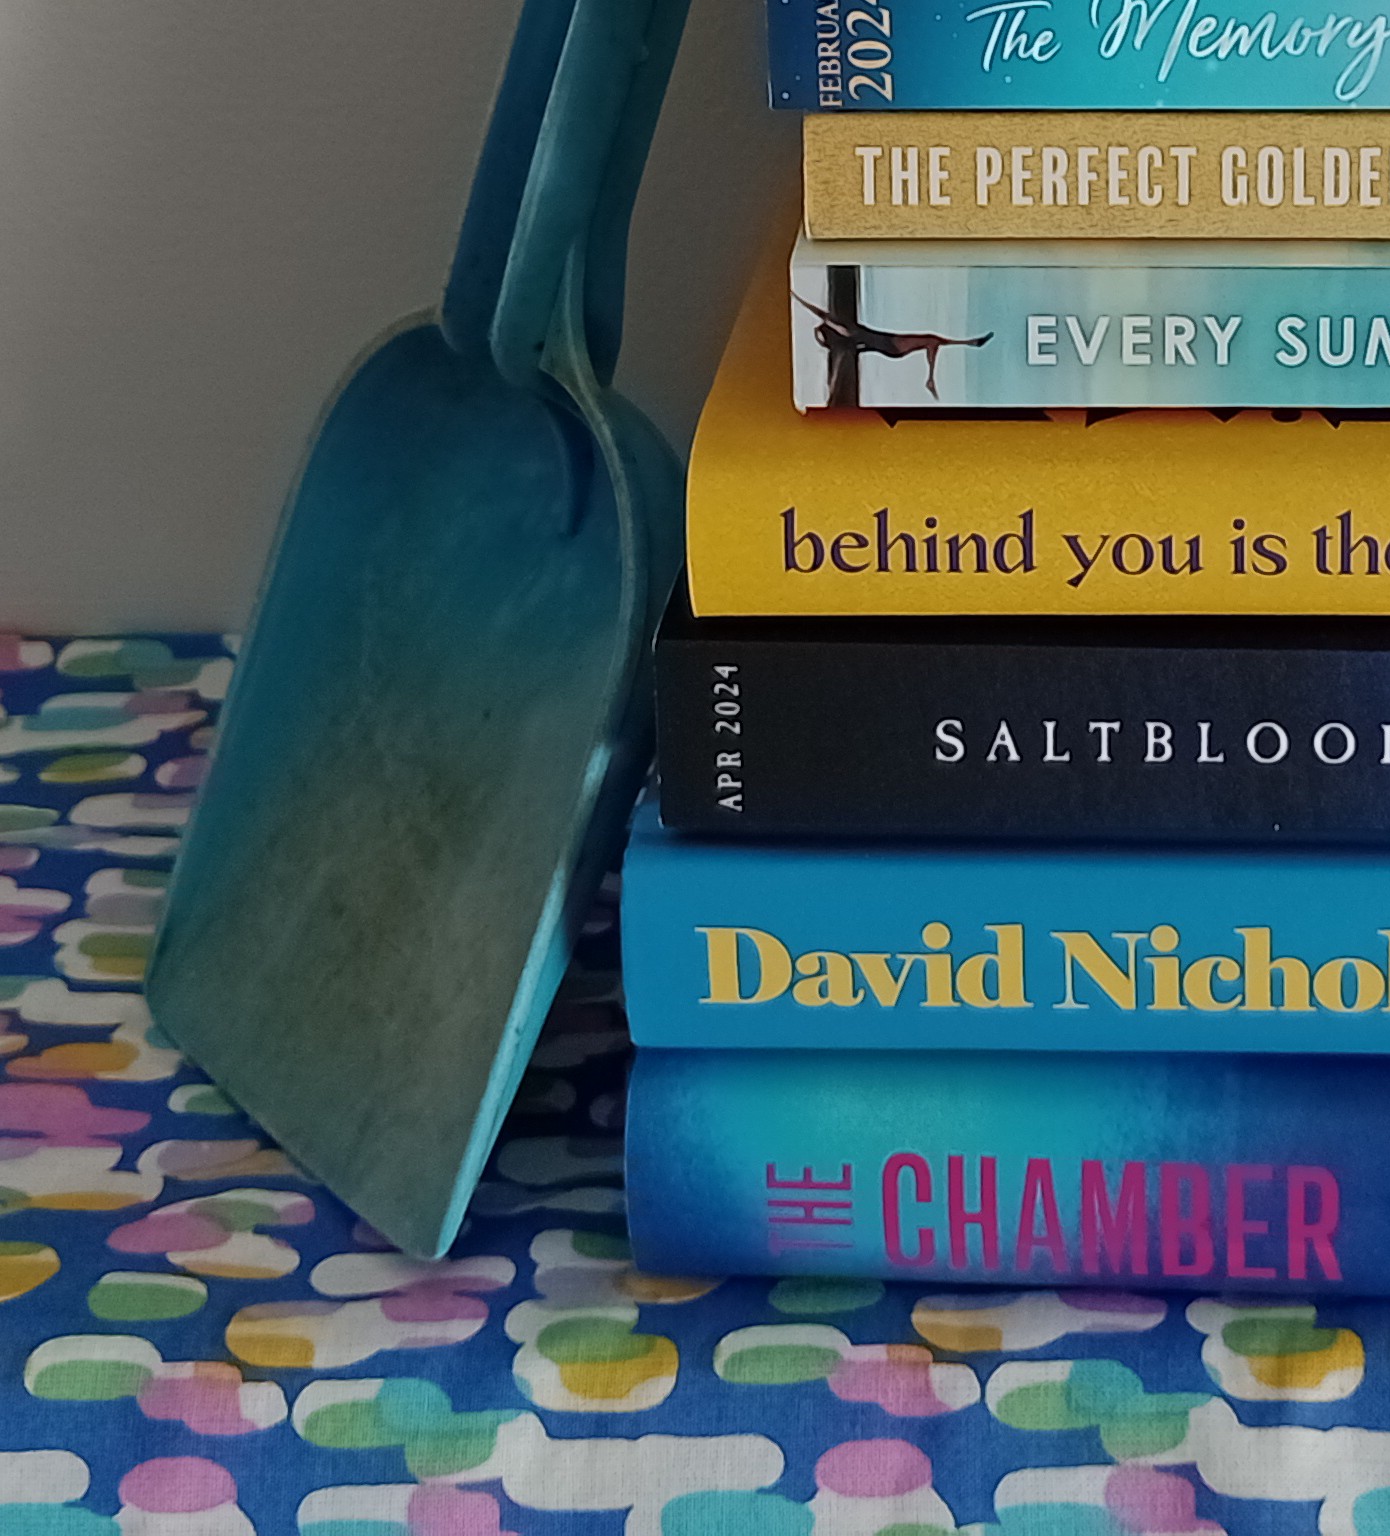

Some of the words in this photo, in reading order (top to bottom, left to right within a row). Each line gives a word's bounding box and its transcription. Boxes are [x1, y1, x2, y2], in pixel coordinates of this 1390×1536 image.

[855, 146, 950, 207] THE
[975, 146, 1198, 207] PERFECT
[1027, 314, 1244, 368] EVERY
[779, 507, 1037, 576] behind
[1062, 533, 1204, 589] you
[1230, 518, 1288, 577] is
[712, 665, 741, 735] 2024
[716, 751, 743, 812] APR
[694, 921, 1034, 1010] David
[764, 1160, 855, 1258] THE
[882, 1151, 1345, 1282] CHAMBER
